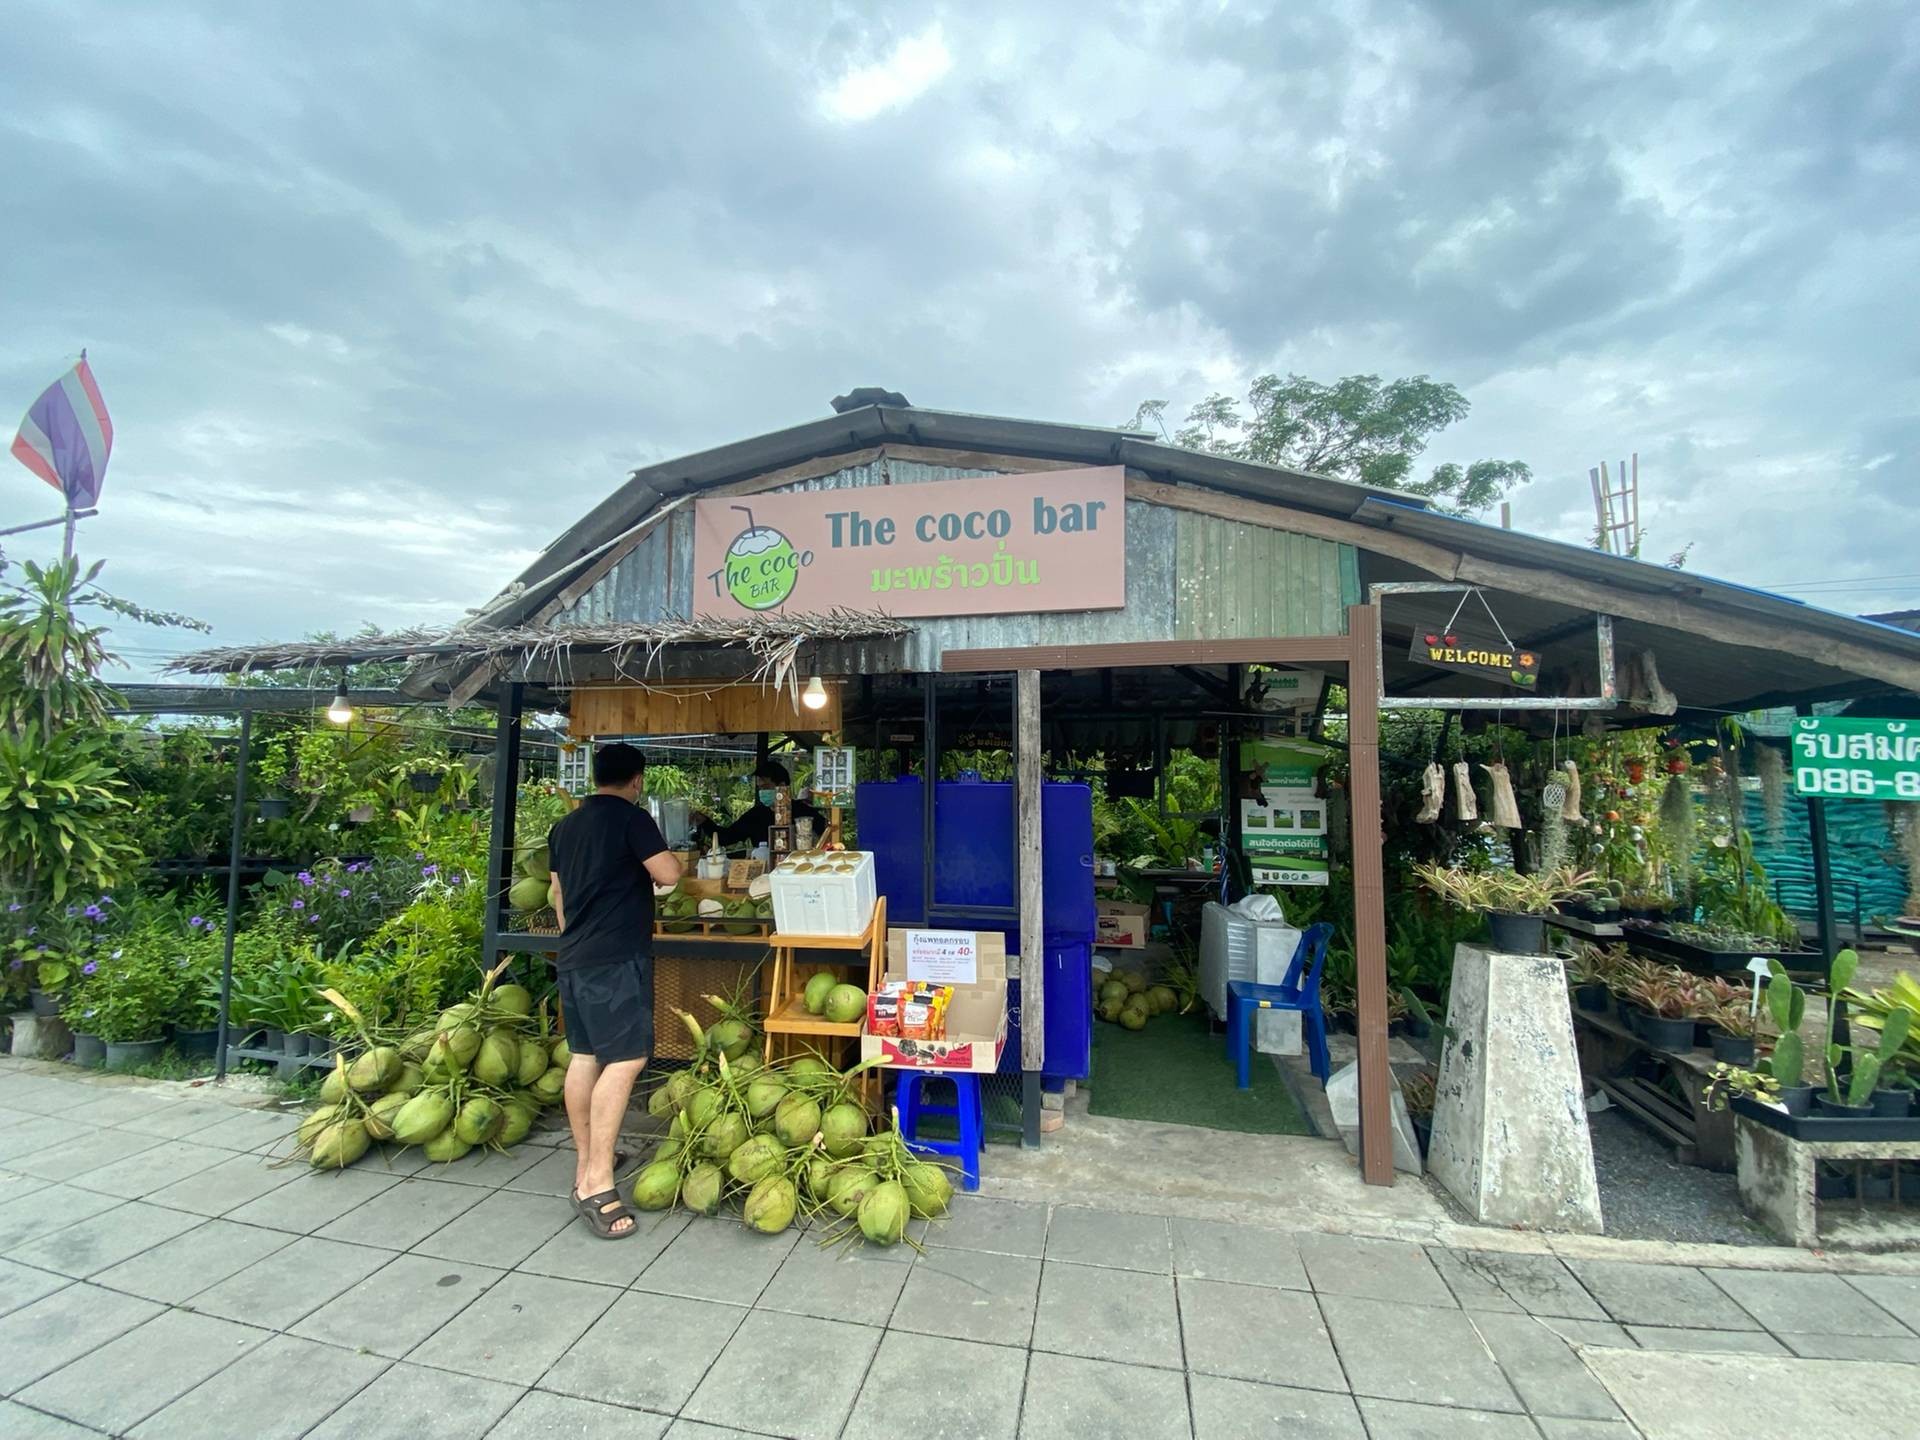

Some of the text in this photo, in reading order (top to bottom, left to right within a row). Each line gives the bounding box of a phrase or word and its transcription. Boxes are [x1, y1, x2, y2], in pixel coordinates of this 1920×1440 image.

[825, 497, 1106, 549] The coco bar
[706, 550, 814, 598] The coco
[750, 577, 780, 599] BAR
[869, 541, 1041, 593] มะพร้าวปั่น
[1429, 647, 1513, 668] WELCOME
